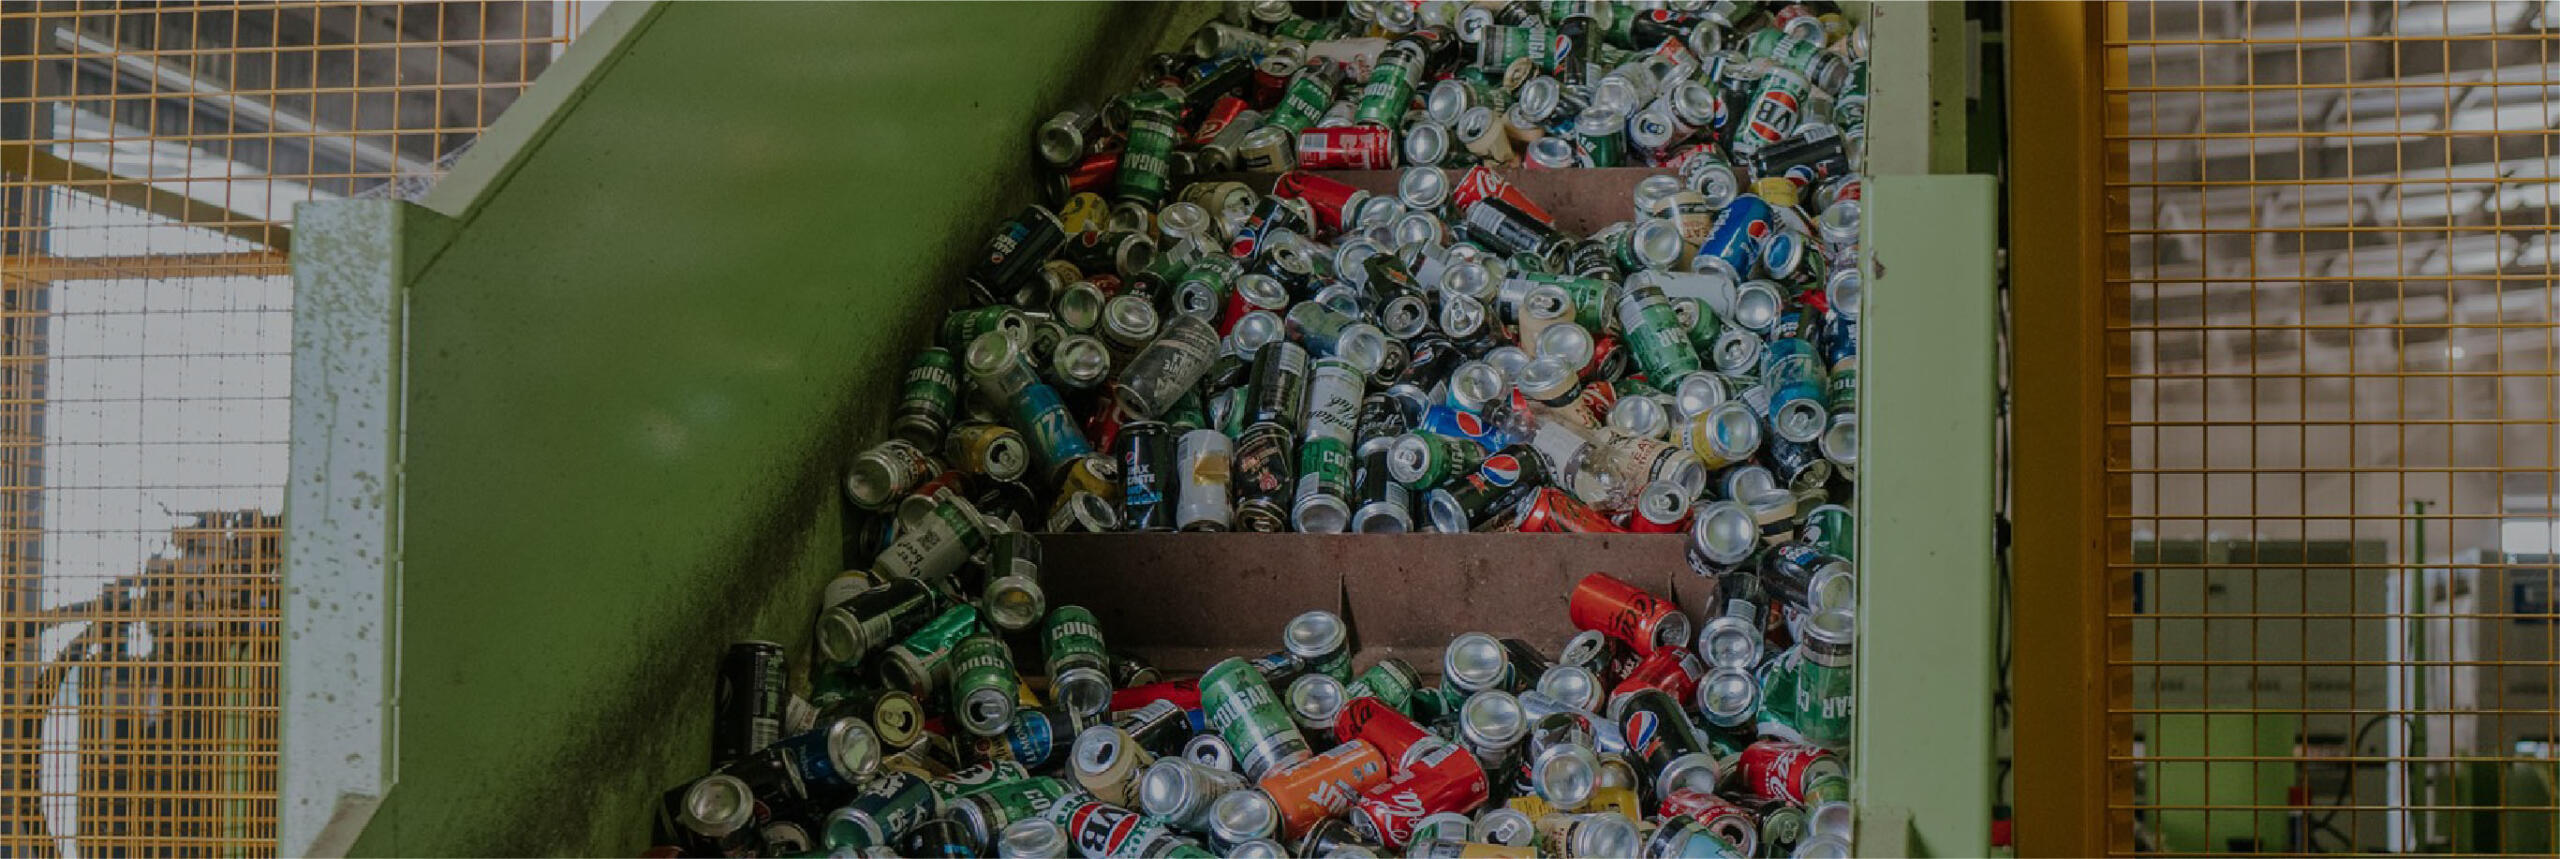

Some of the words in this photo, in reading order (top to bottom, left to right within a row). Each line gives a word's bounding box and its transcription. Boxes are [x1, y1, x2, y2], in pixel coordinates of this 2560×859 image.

[1757, 100, 1793, 134] VB
[1214, 684, 1273, 735] COUGAR
[1082, 806, 1134, 852] VB
